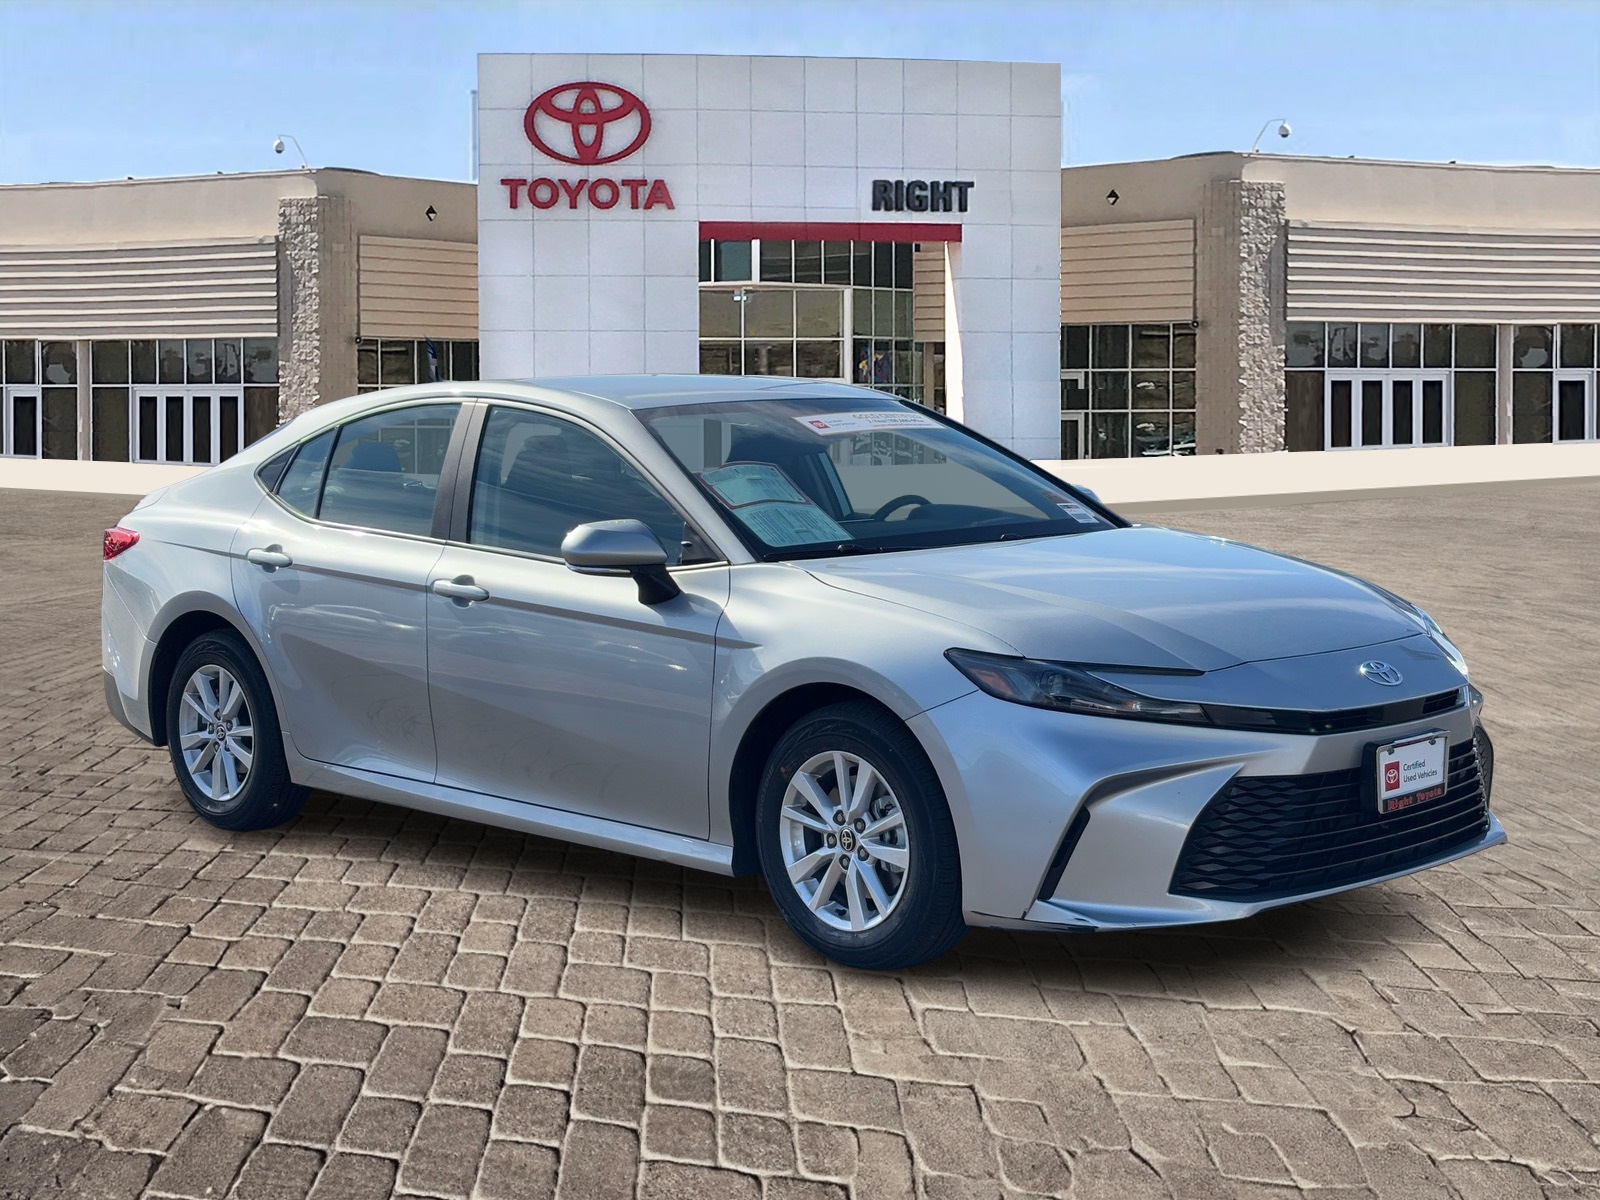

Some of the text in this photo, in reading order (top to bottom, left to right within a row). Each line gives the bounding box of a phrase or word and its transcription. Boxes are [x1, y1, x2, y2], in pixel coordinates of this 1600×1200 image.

[500, 178, 675, 210] TOYOTA
[871, 179, 975, 213] RIGHT
[1403, 760, 1425, 771] Certified
[1403, 769, 1437, 782] Used Vehicles
[1388, 788, 1441, 810] Right Toyota
